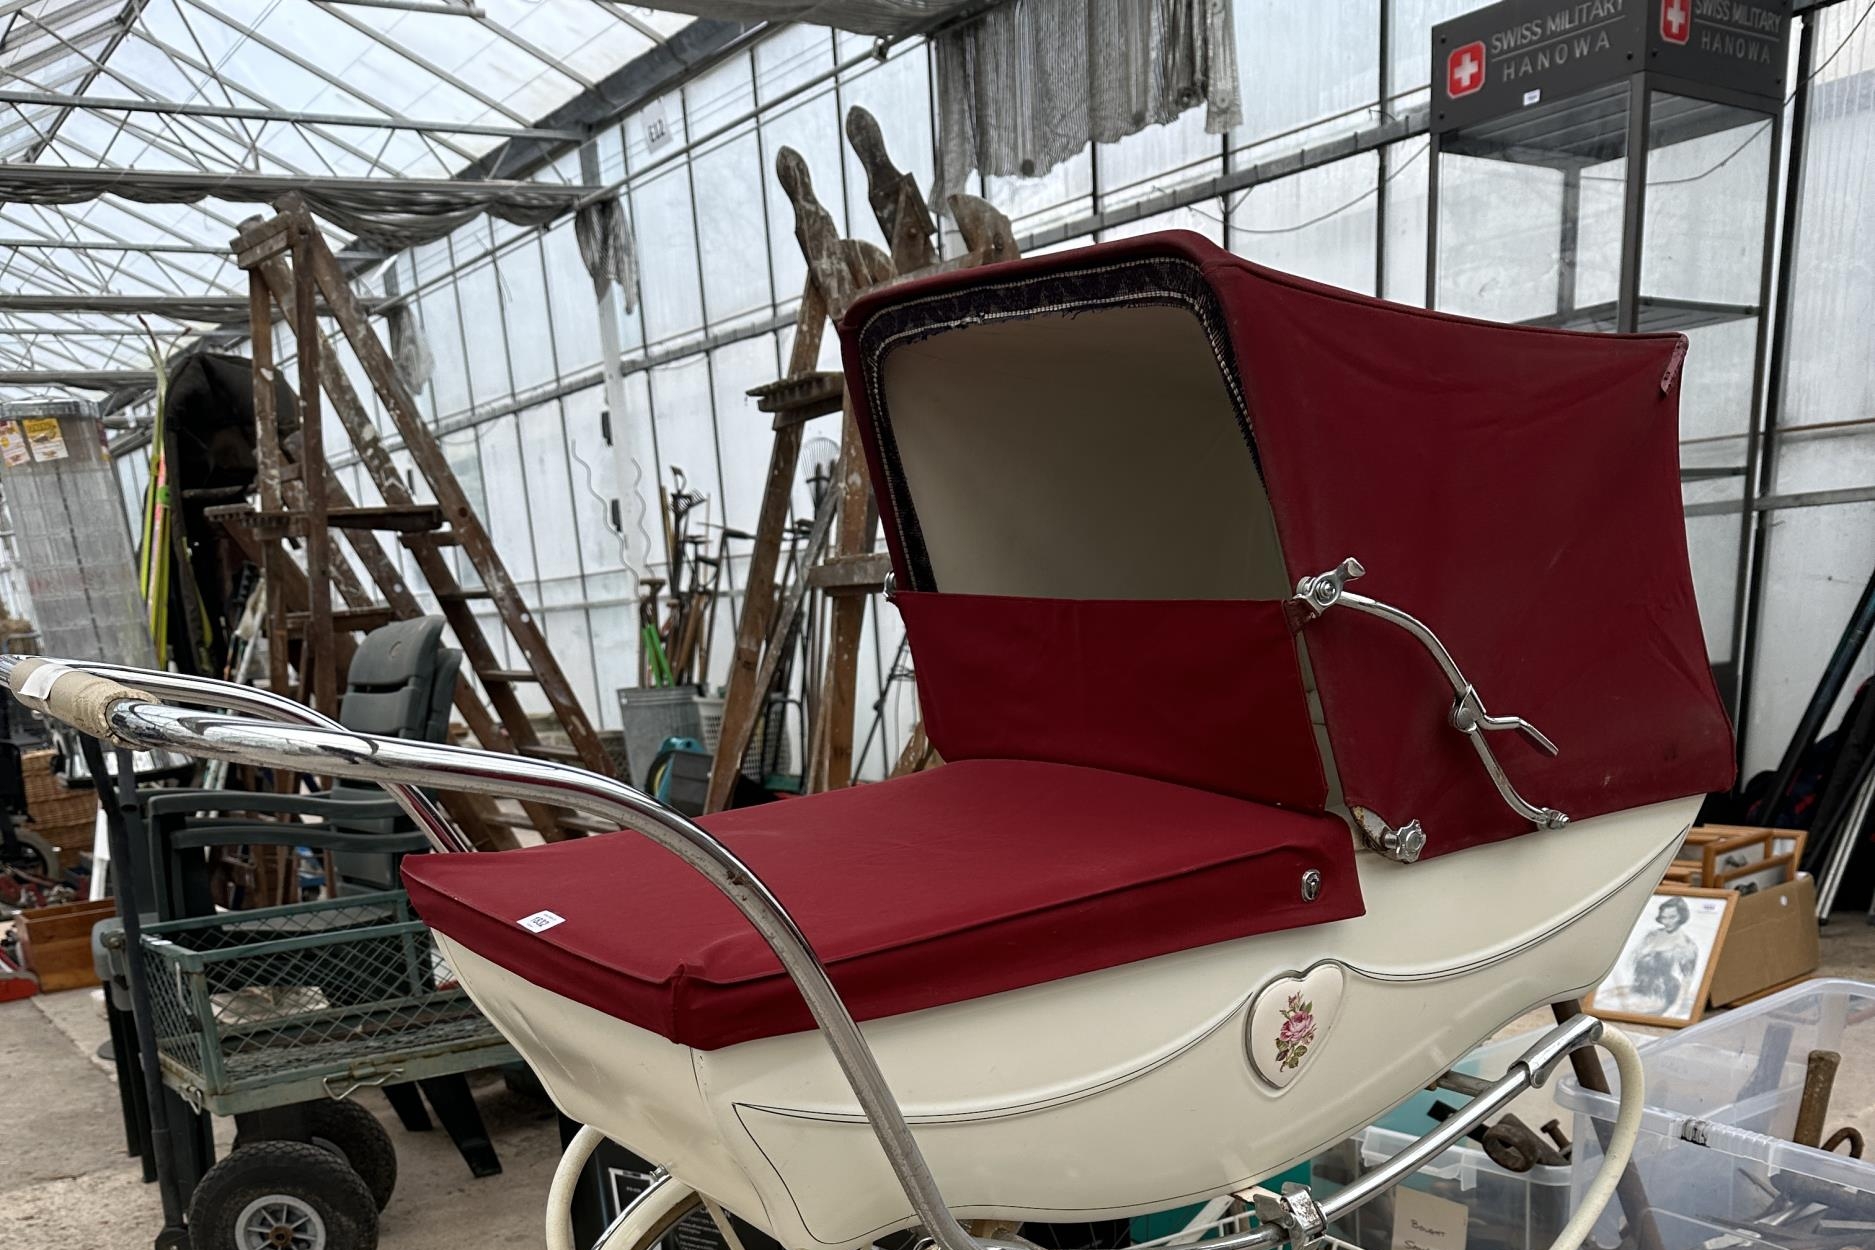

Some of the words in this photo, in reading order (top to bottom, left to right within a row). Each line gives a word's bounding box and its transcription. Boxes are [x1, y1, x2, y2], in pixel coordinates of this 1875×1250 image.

[1694, 0, 1731, 21] SWISS
[1732, 2, 1781, 33] MILITARY
[1491, 20, 1542, 54] SWISS
[1701, 30, 1770, 64] HANOWA
[1503, 30, 1610, 82] HANOWA
